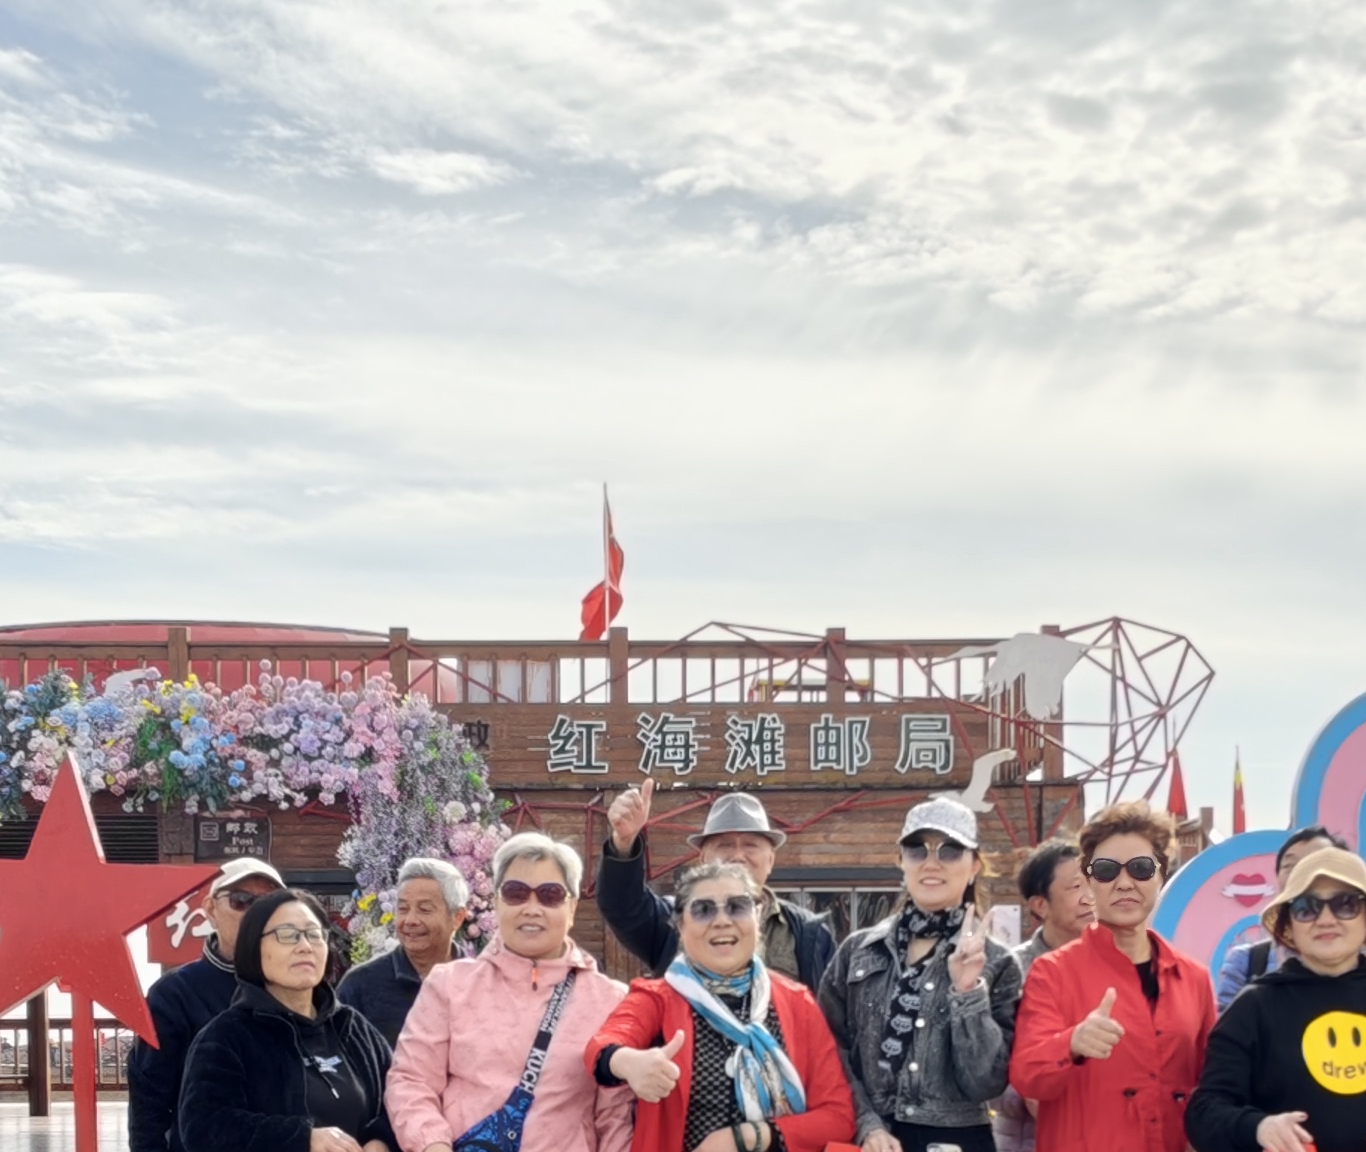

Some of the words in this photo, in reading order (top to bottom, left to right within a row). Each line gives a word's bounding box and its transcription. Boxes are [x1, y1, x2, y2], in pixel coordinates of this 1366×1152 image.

[548, 712, 954, 775] 红海滩邮局
[232, 837, 254, 846] Post
